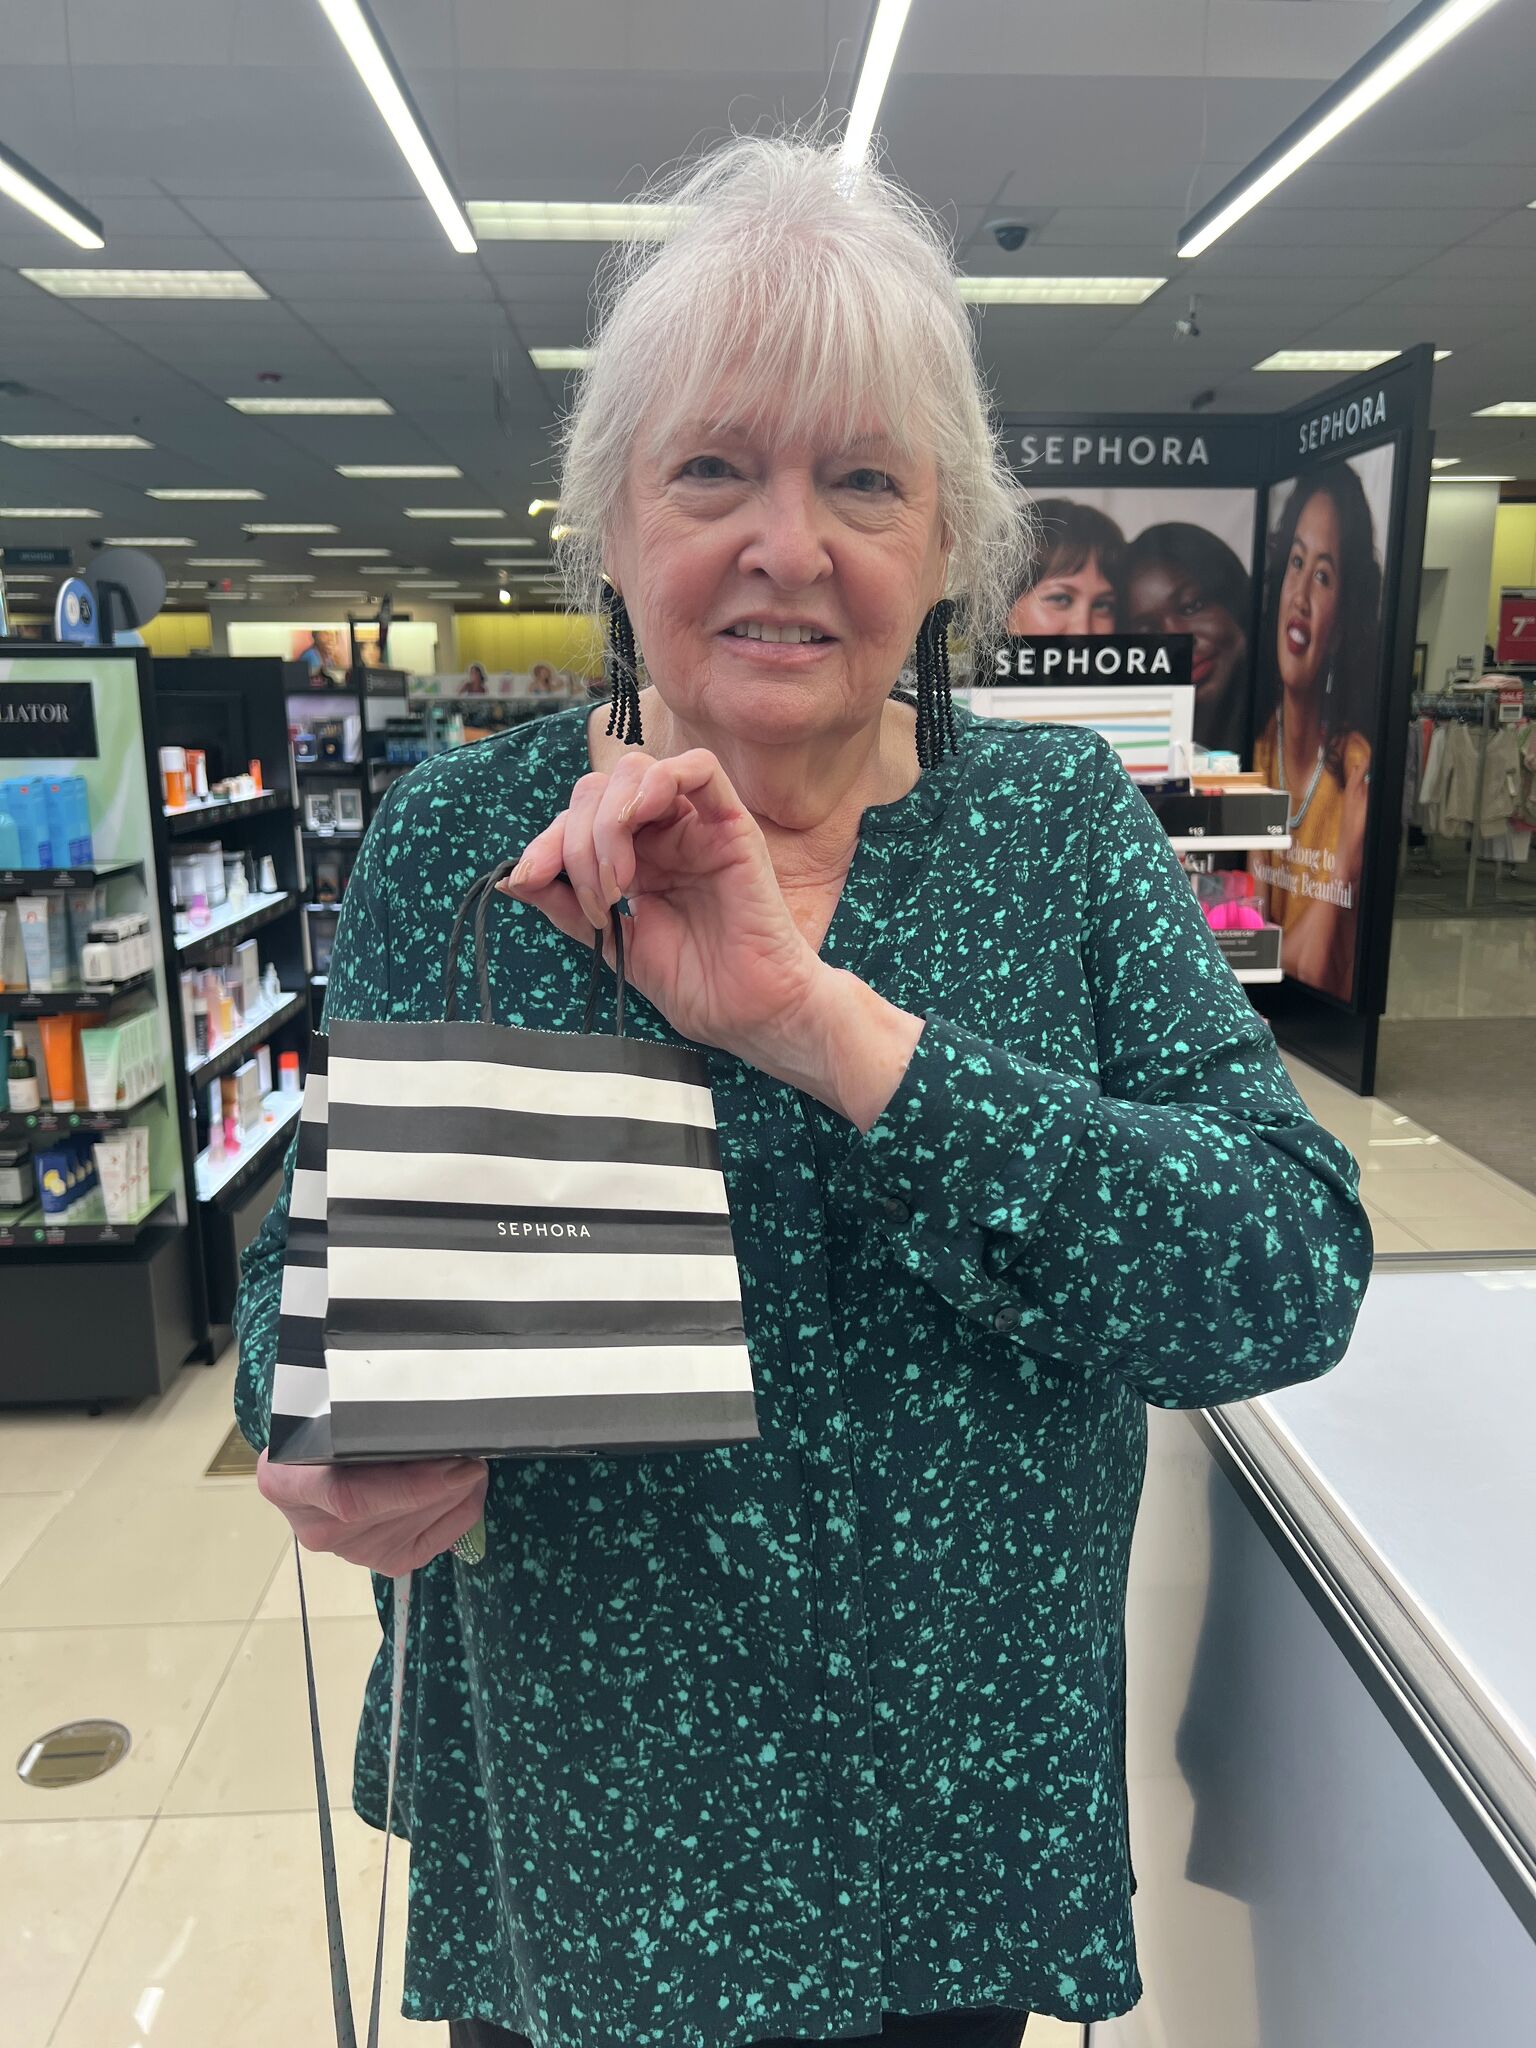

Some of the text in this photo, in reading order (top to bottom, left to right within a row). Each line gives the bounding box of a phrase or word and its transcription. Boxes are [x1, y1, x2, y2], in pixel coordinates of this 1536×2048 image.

[1299, 390, 1386, 454] SEPHORA
[1021, 435, 1209, 466] SEPHORA
[996, 647, 1172, 676] SEPHORA
[1323, 848, 1336, 872] to
[1302, 872, 1352, 909] Beautiful
[497, 1222, 591, 1238] SEPHORA
